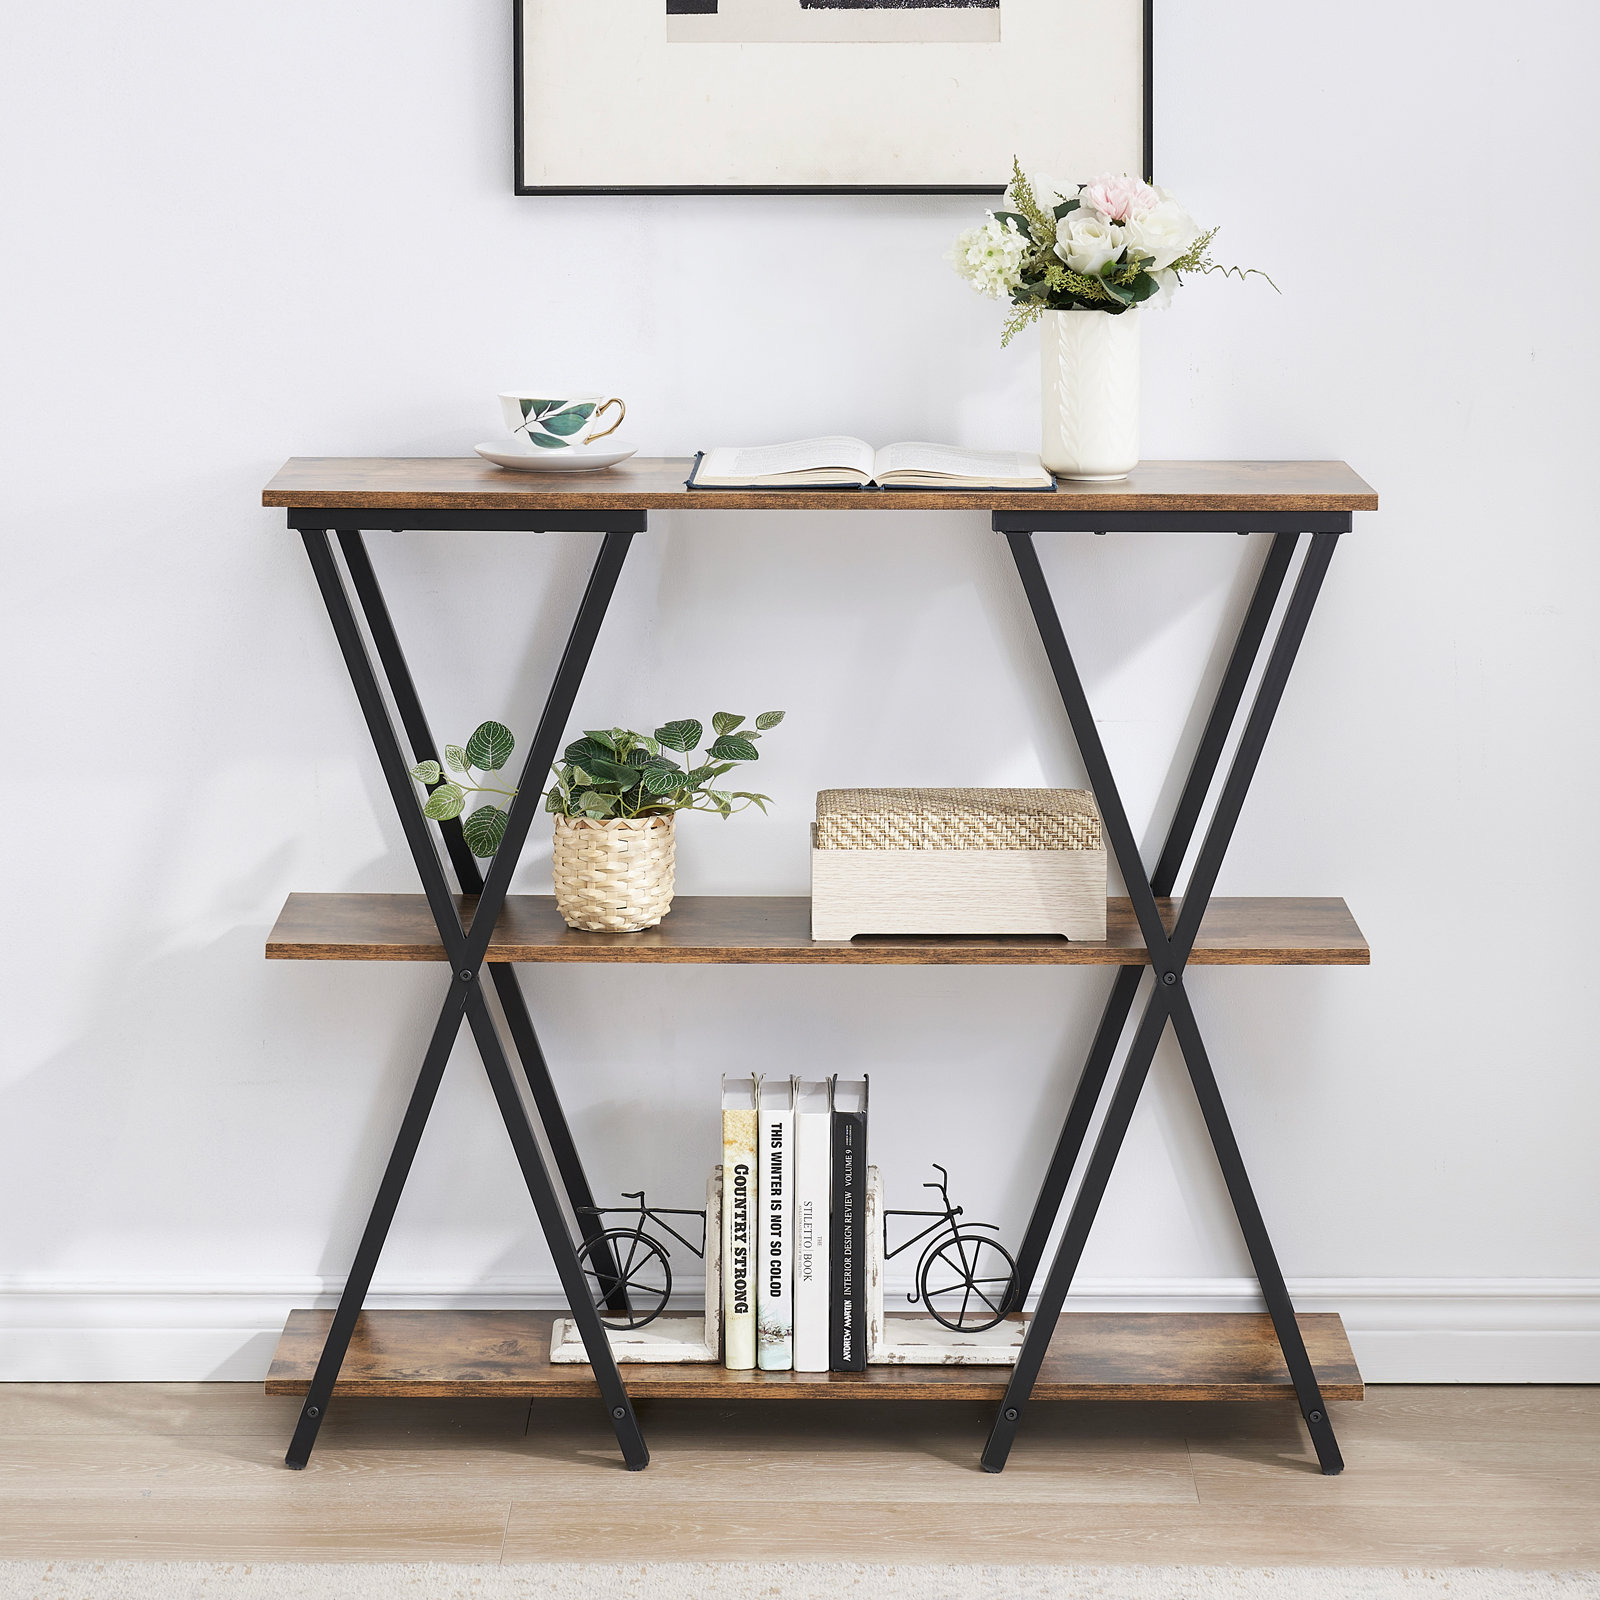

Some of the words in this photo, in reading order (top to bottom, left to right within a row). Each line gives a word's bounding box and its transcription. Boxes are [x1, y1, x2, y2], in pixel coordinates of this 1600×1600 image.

[771, 1123, 782, 1149] THIS
[770, 1152, 782, 1196] WINTER
[844, 1155, 852, 1187] VOLUME
[734, 1164, 749, 1243] COUNTRY
[770, 1200, 782, 1211] IS
[844, 1191, 852, 1223] REVIEW
[770, 1215, 782, 1238] NOT
[803, 1200, 813, 1249] STILETTO
[844, 1224, 852, 1255] DESIGN
[770, 1241, 782, 1257] SO
[734, 1247, 749, 1314] STRONG
[770, 1260, 782, 1298] COLOD
[803, 1253, 813, 1282] BOOK
[843, 1257, 852, 1296] INTERIOR
[843, 1299, 852, 1328] MARTIN
[843, 1328, 852, 1361] ANDREW
